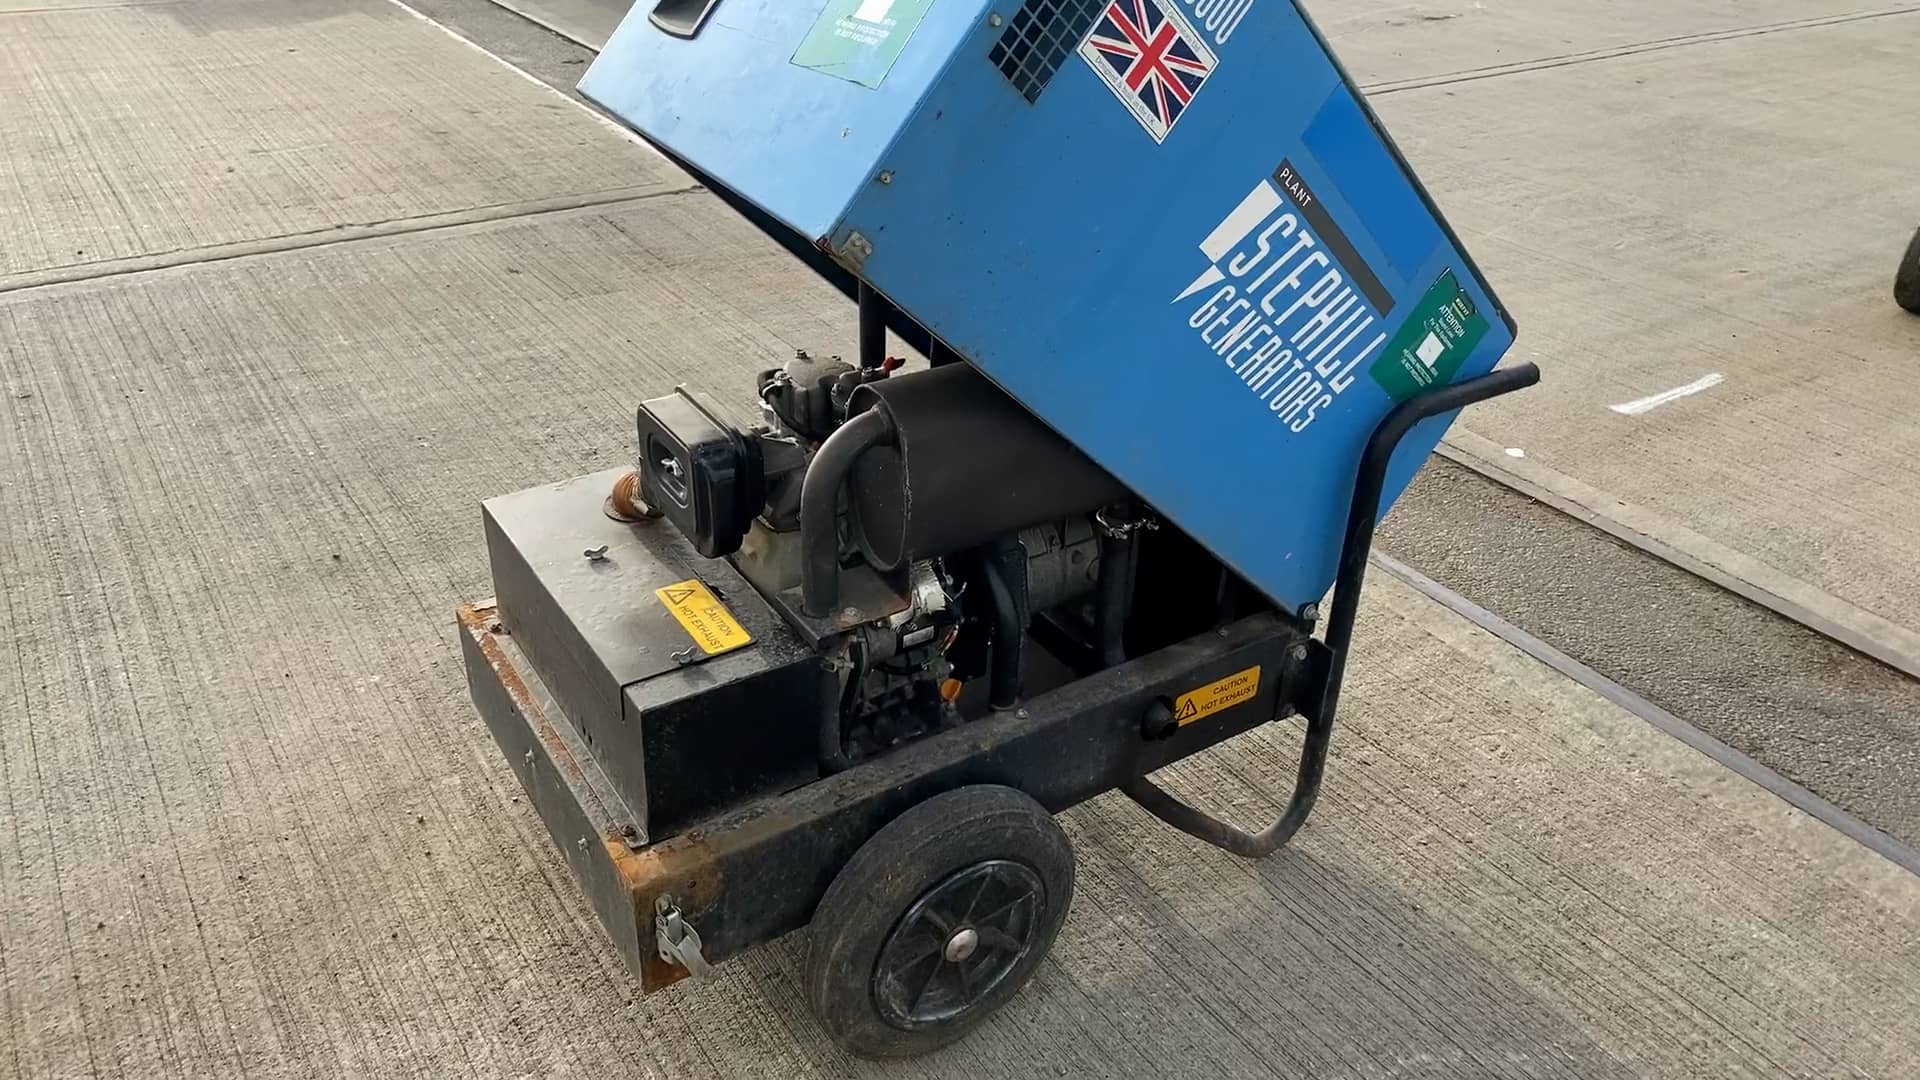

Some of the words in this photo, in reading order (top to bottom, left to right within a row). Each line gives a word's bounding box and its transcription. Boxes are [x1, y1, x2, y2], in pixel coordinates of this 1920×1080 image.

[1279, 167, 1312, 207] PLANT
[1228, 213, 1387, 394] STEPHILL
[1439, 304, 1465, 337] ATTENTION
[1188, 285, 1333, 433] GENERATORS
[680, 605, 698, 620] HOT
[691, 619, 724, 649] EXHAUST
[703, 607, 733, 636] CAUTION
[1201, 699, 1218, 711] HOT
[1219, 684, 1256, 705] EXHAUST
[1212, 675, 1249, 695] CAUTION
